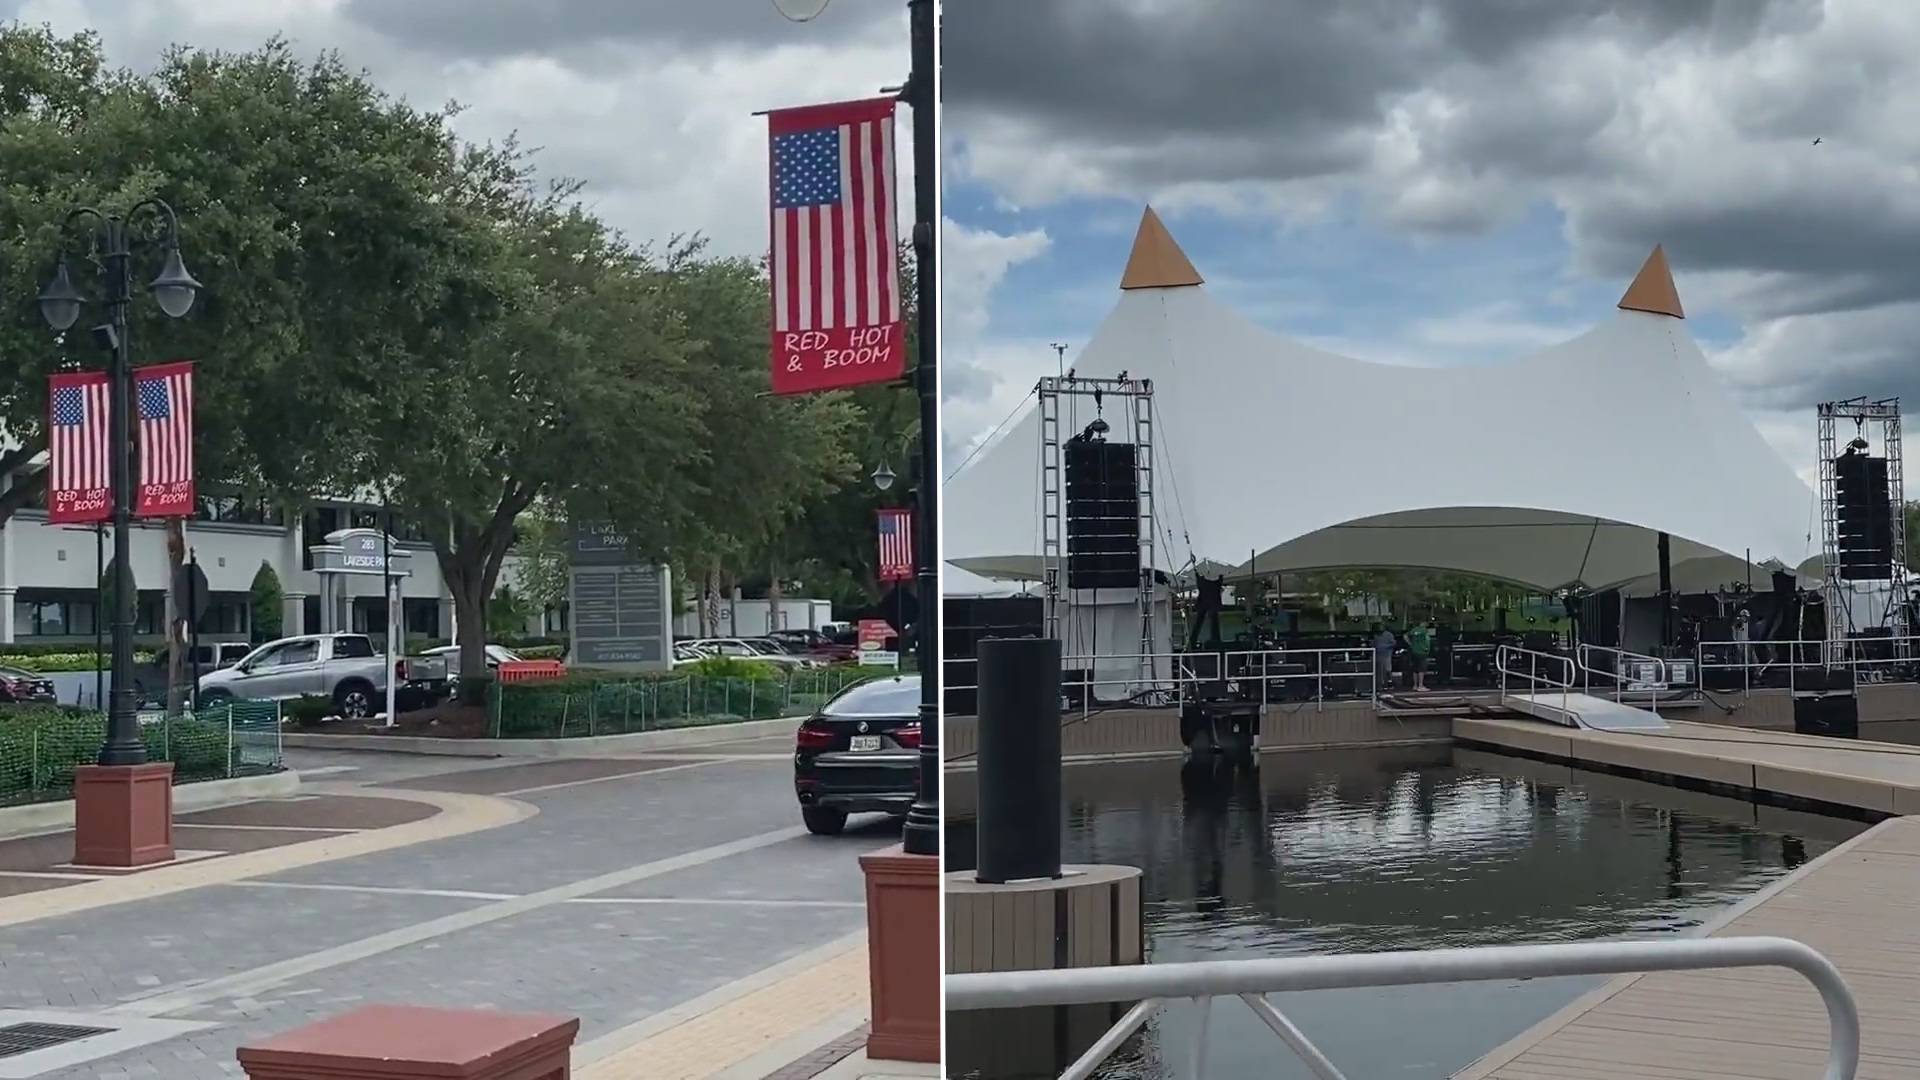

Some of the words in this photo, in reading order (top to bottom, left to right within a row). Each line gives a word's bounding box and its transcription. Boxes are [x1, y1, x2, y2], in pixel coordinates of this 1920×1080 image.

[784, 331, 829, 352] RED
[850, 325, 893, 348] HOT
[786, 354, 803, 372] &
[823, 346, 892, 369] BOOM
[56, 491, 78, 501] RED
[86, 488, 106, 500] HOT
[145, 485, 165, 496] RED
[172, 481, 189, 493] HOT
[159, 492, 188, 505] BOOM
[73, 500, 105, 511] BOOM
[375, 556, 392, 568] PAK
